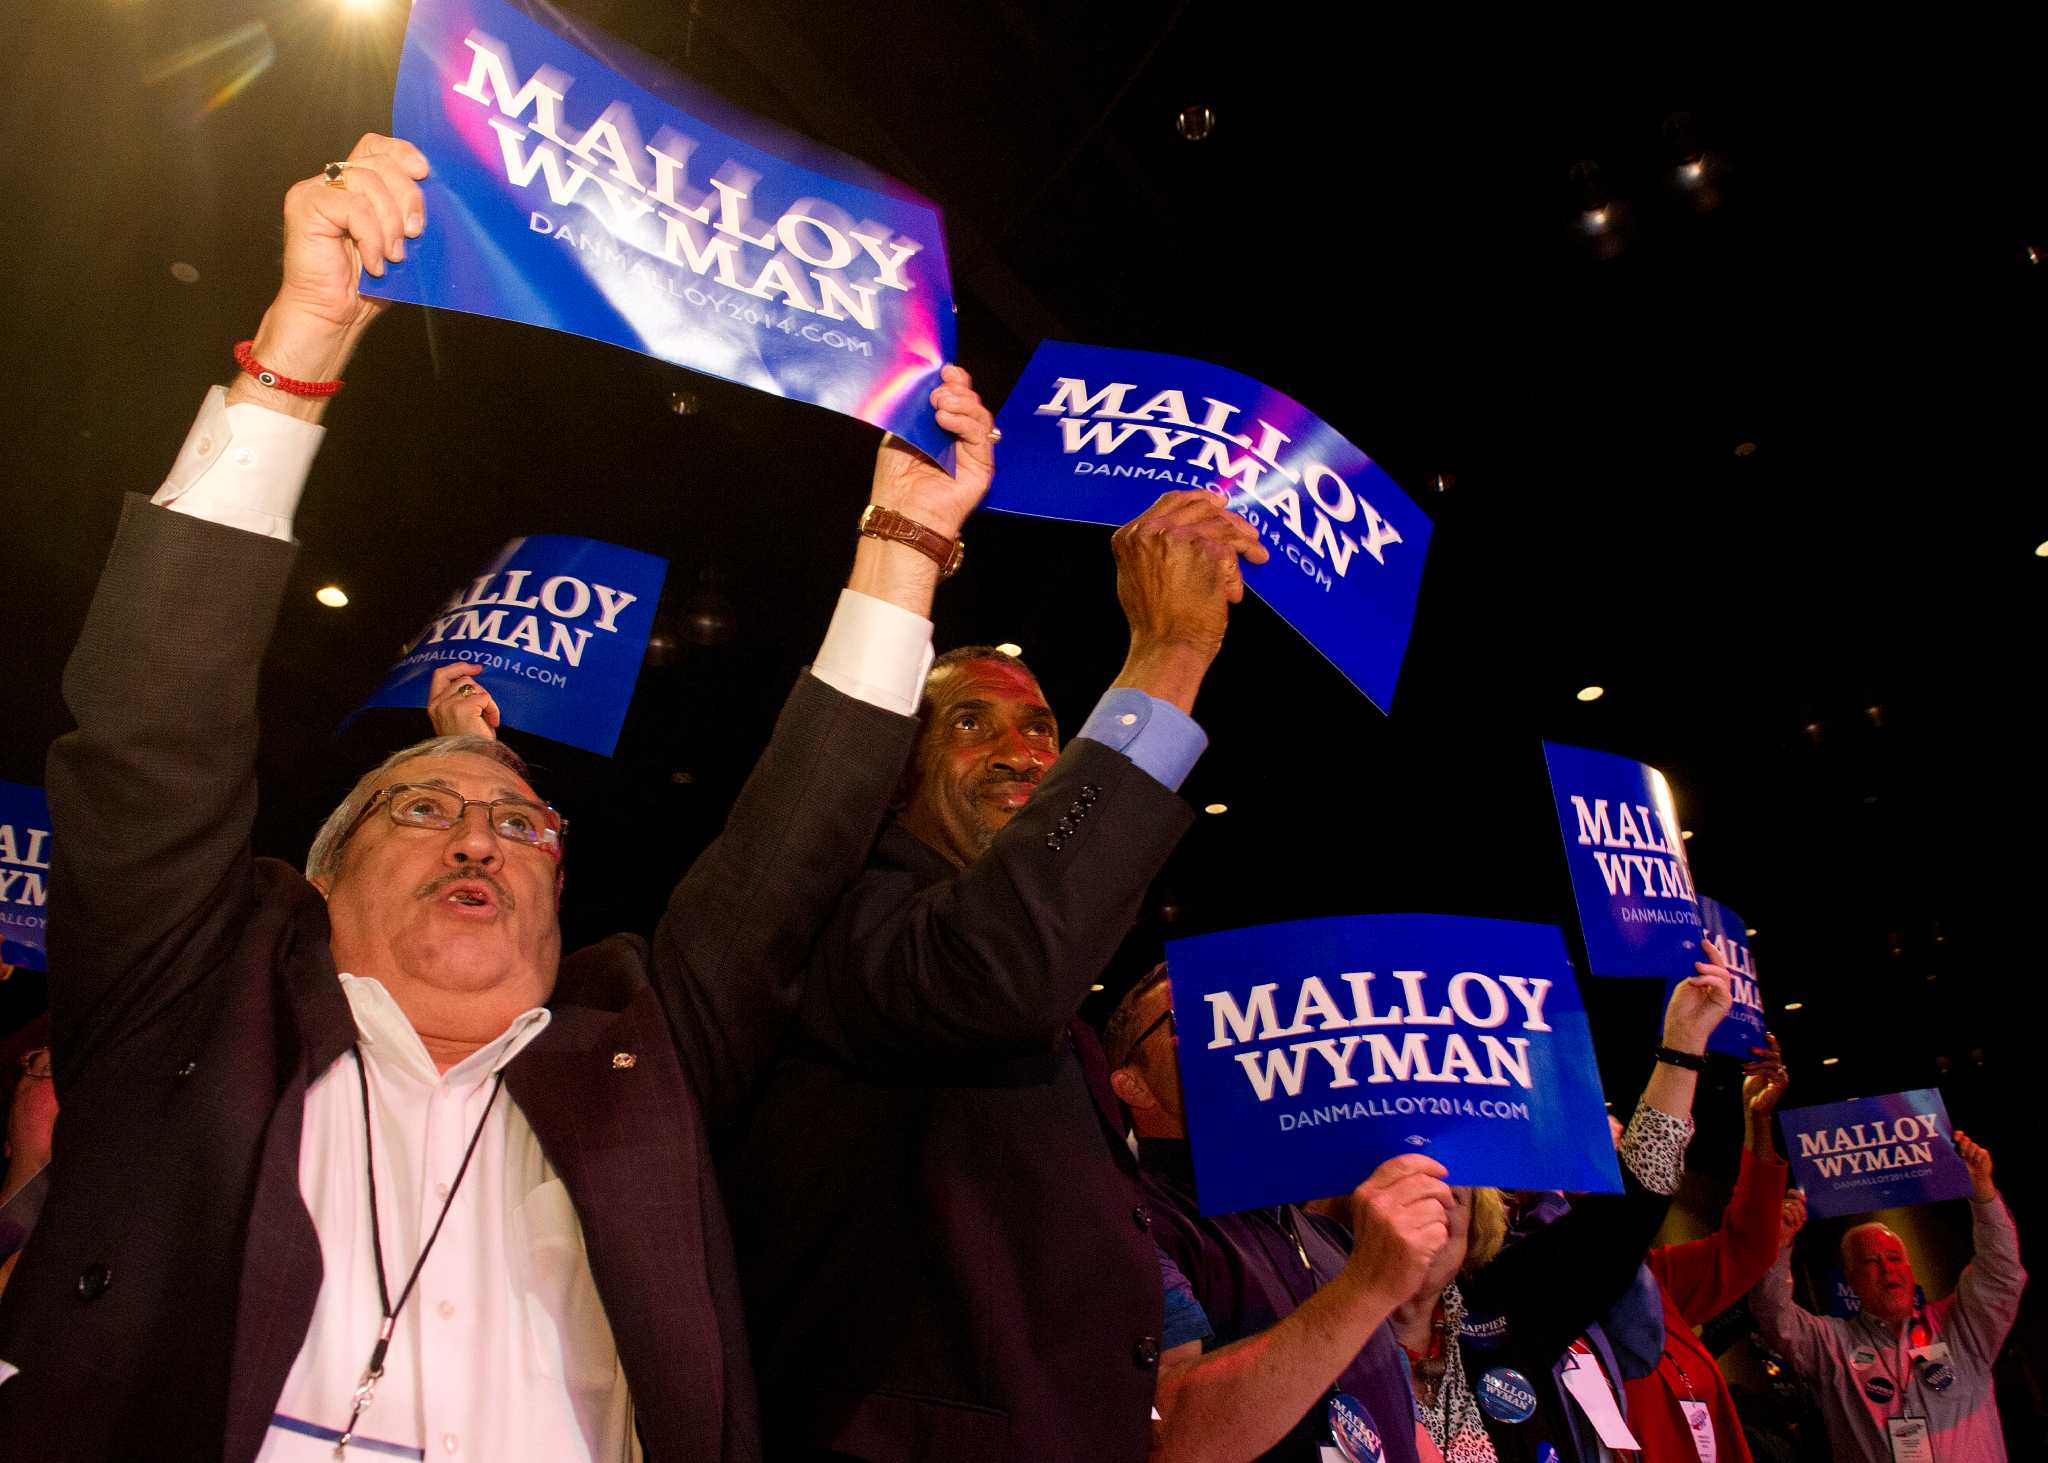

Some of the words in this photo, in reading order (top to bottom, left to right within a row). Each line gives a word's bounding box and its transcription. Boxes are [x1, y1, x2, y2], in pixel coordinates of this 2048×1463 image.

[452, 36, 917, 291] MALLOY
[487, 118, 882, 330] WYMAN
[1034, 377, 1403, 565] MALLOY
[1057, 417, 1359, 577] WYMAN
[1074, 460, 1333, 592] DANMALLO2014.COM
[450, 570, 637, 633] LLOY
[425, 609, 593, 667] YMAN
[1570, 795, 1682, 857] MALL
[1593, 851, 1697, 904] WYMA
[1203, 970, 1553, 1050] MALLOY
[1234, 1032, 1533, 1101] WYMAN
[1279, 1097, 1530, 1132] DANMALLOY2014.COM
[1797, 1113, 1939, 1157] MALLOY
[1812, 1142, 1933, 1178] WYMAN
